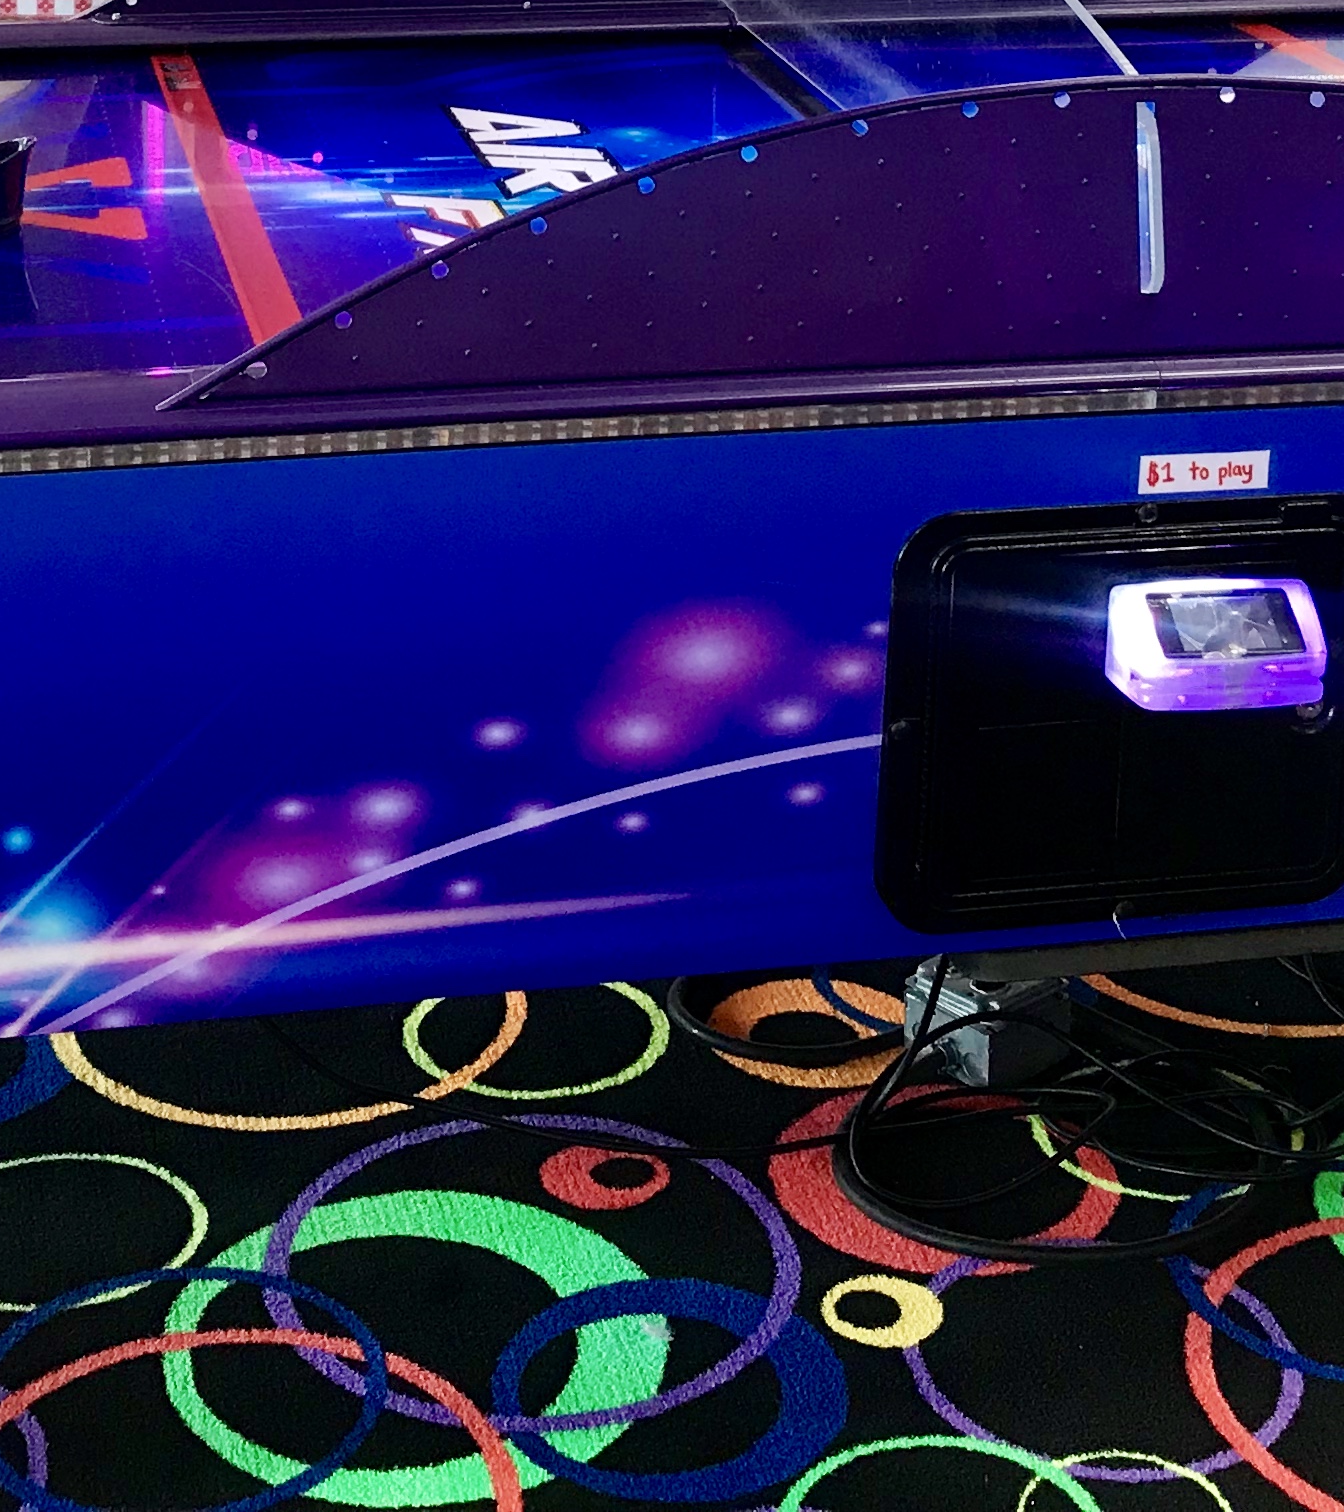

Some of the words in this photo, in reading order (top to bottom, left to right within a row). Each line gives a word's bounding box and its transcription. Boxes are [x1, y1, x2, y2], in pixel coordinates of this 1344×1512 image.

[1146, 460, 1175, 487] $1
[1188, 461, 1210, 481] to
[1218, 461, 1254, 486] play
